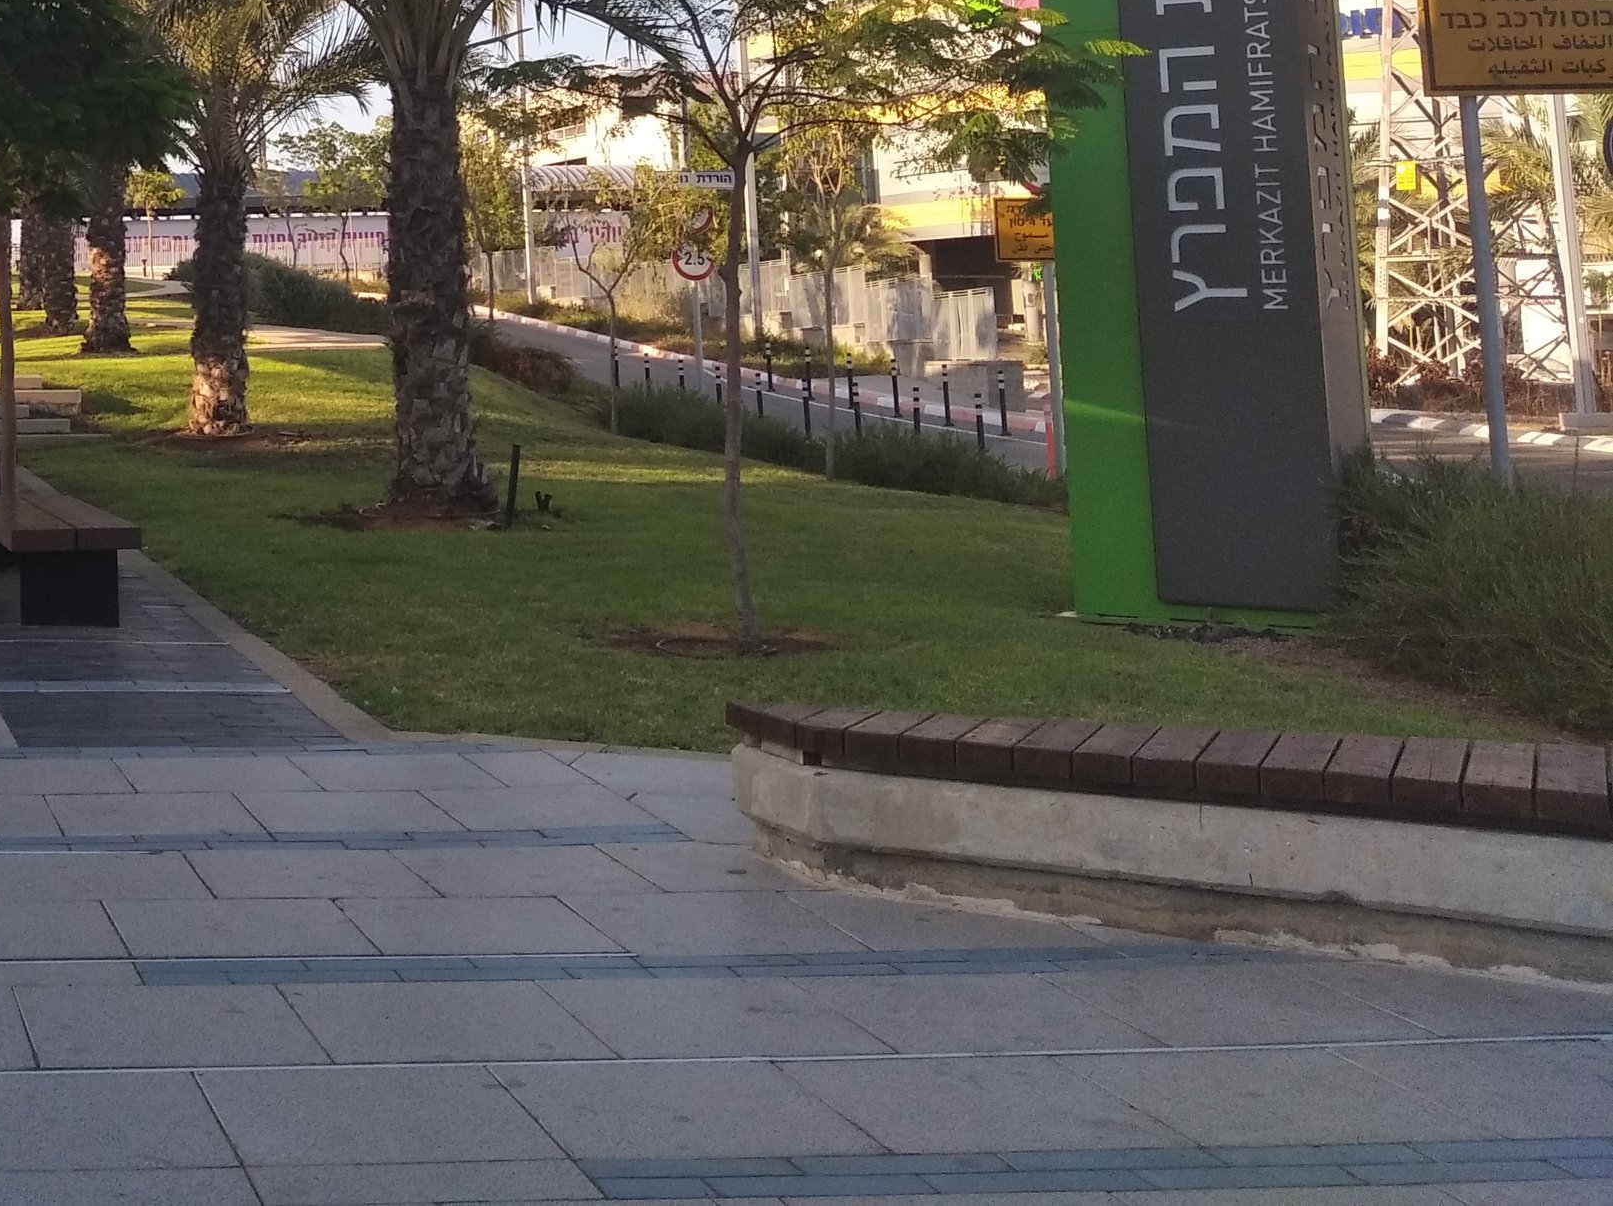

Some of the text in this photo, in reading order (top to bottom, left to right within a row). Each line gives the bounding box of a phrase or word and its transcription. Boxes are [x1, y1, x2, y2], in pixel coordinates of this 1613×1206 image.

[1439, 11, 1488, 30] כבד
[1496, 5, 1567, 29] ולרכב
[696, 174, 732, 184] הורדת
[1157, 44, 1249, 313] המפרץ
[1254, 163, 1289, 311] MERKAZIT
[684, 251, 705, 266] 2.5
